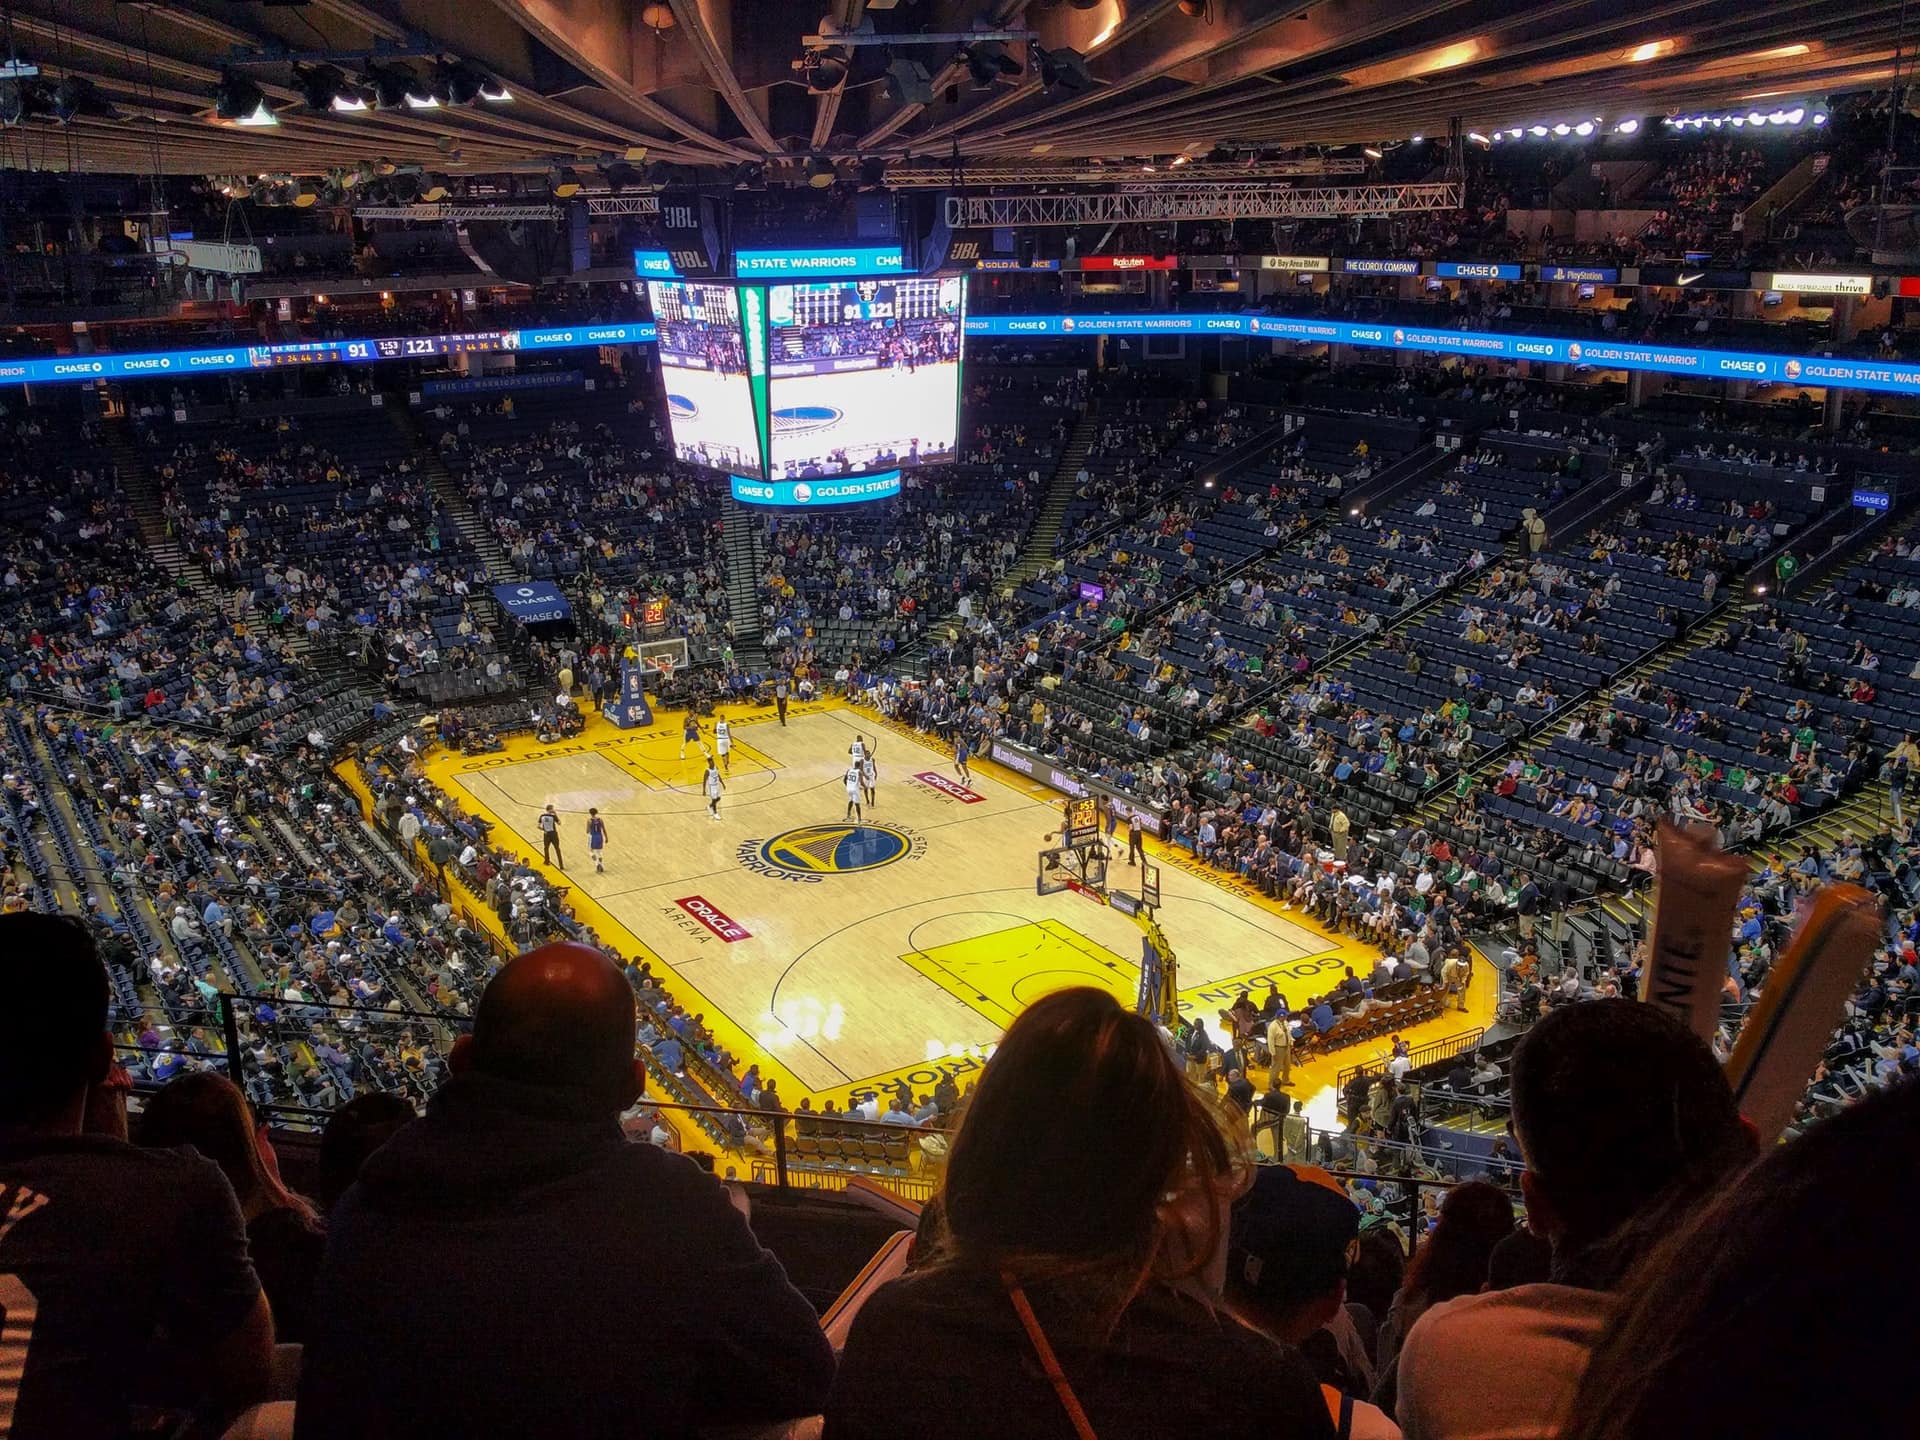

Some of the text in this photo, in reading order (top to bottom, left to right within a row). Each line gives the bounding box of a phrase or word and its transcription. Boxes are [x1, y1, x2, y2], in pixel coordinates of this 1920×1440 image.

[664, 207, 697, 229] JBL
[951, 242, 980, 260] JBL
[671, 251, 707, 269] JBL
[751, 259, 788, 269] STATE
[790, 256, 857, 268] WARRIORS
[985, 261, 1008, 269] GOLD
[1113, 257, 1145, 266] Rakuten
[1278, 259, 1319, 268] Bay Area BMW
[1346, 261, 1416, 273] THE CLOROX COMPANY
[1457, 266, 1488, 276] CHASE
[1567, 271, 1603, 281] PlayStation
[1835, 282, 1864, 292] thrive
[869, 303, 893, 318] 121
[1009, 321, 1038, 329] CHASE
[1078, 320, 1192, 328] GOLDEN STATE WARRIORS
[1207, 320, 1235, 328] CHASE
[1261, 323, 1287, 331] GOLDEN
[1288, 324, 1306, 333] STATE
[534, 333, 564, 343] CHASE
[589, 330, 617, 339] CHASE
[1352, 330, 1375, 339] CHASE
[380, 341, 398, 350] 1:53
[406, 340, 435, 353] 121
[1406, 334, 1504, 349] GOLDEN STATE WARRIORS
[348, 344, 368, 357] 91
[1517, 343, 1544, 354] CHASE
[190, 355, 224, 364] CHASE
[1585, 348, 1622, 360] GOLDEN
[1624, 352, 1651, 362] STATE
[55, 364, 91, 373] CHASE
[124, 360, 159, 369] CHASE
[1721, 360, 1755, 371] CHASE
[1805, 366, 1853, 378] GOLDEN
[1856, 370, 1890, 382] STATE
[738, 487, 763, 497] CHASE
[816, 485, 864, 496] GOLDEN
[866, 481, 890, 492] STATE
[1854, 495, 1880, 504] CHASE
[508, 596, 556, 605] CHASE
[518, 611, 552, 623] CHASE
[647, 610, 661, 621] 22
[462, 745, 585, 771] GOLDEN
[594, 729, 678, 750] STATE
[903, 779, 955, 805] ARENA
[924, 774, 977, 801] ORACLE
[912, 836, 929, 861] STATE
[736, 838, 825, 884] WARRIORS
[1156, 852, 1255, 898] @WARRIORS
[686, 900, 742, 937] ORACLE
[660, 907, 712, 944] ARENA
[1197, 957, 1345, 1004] GOLDEN
